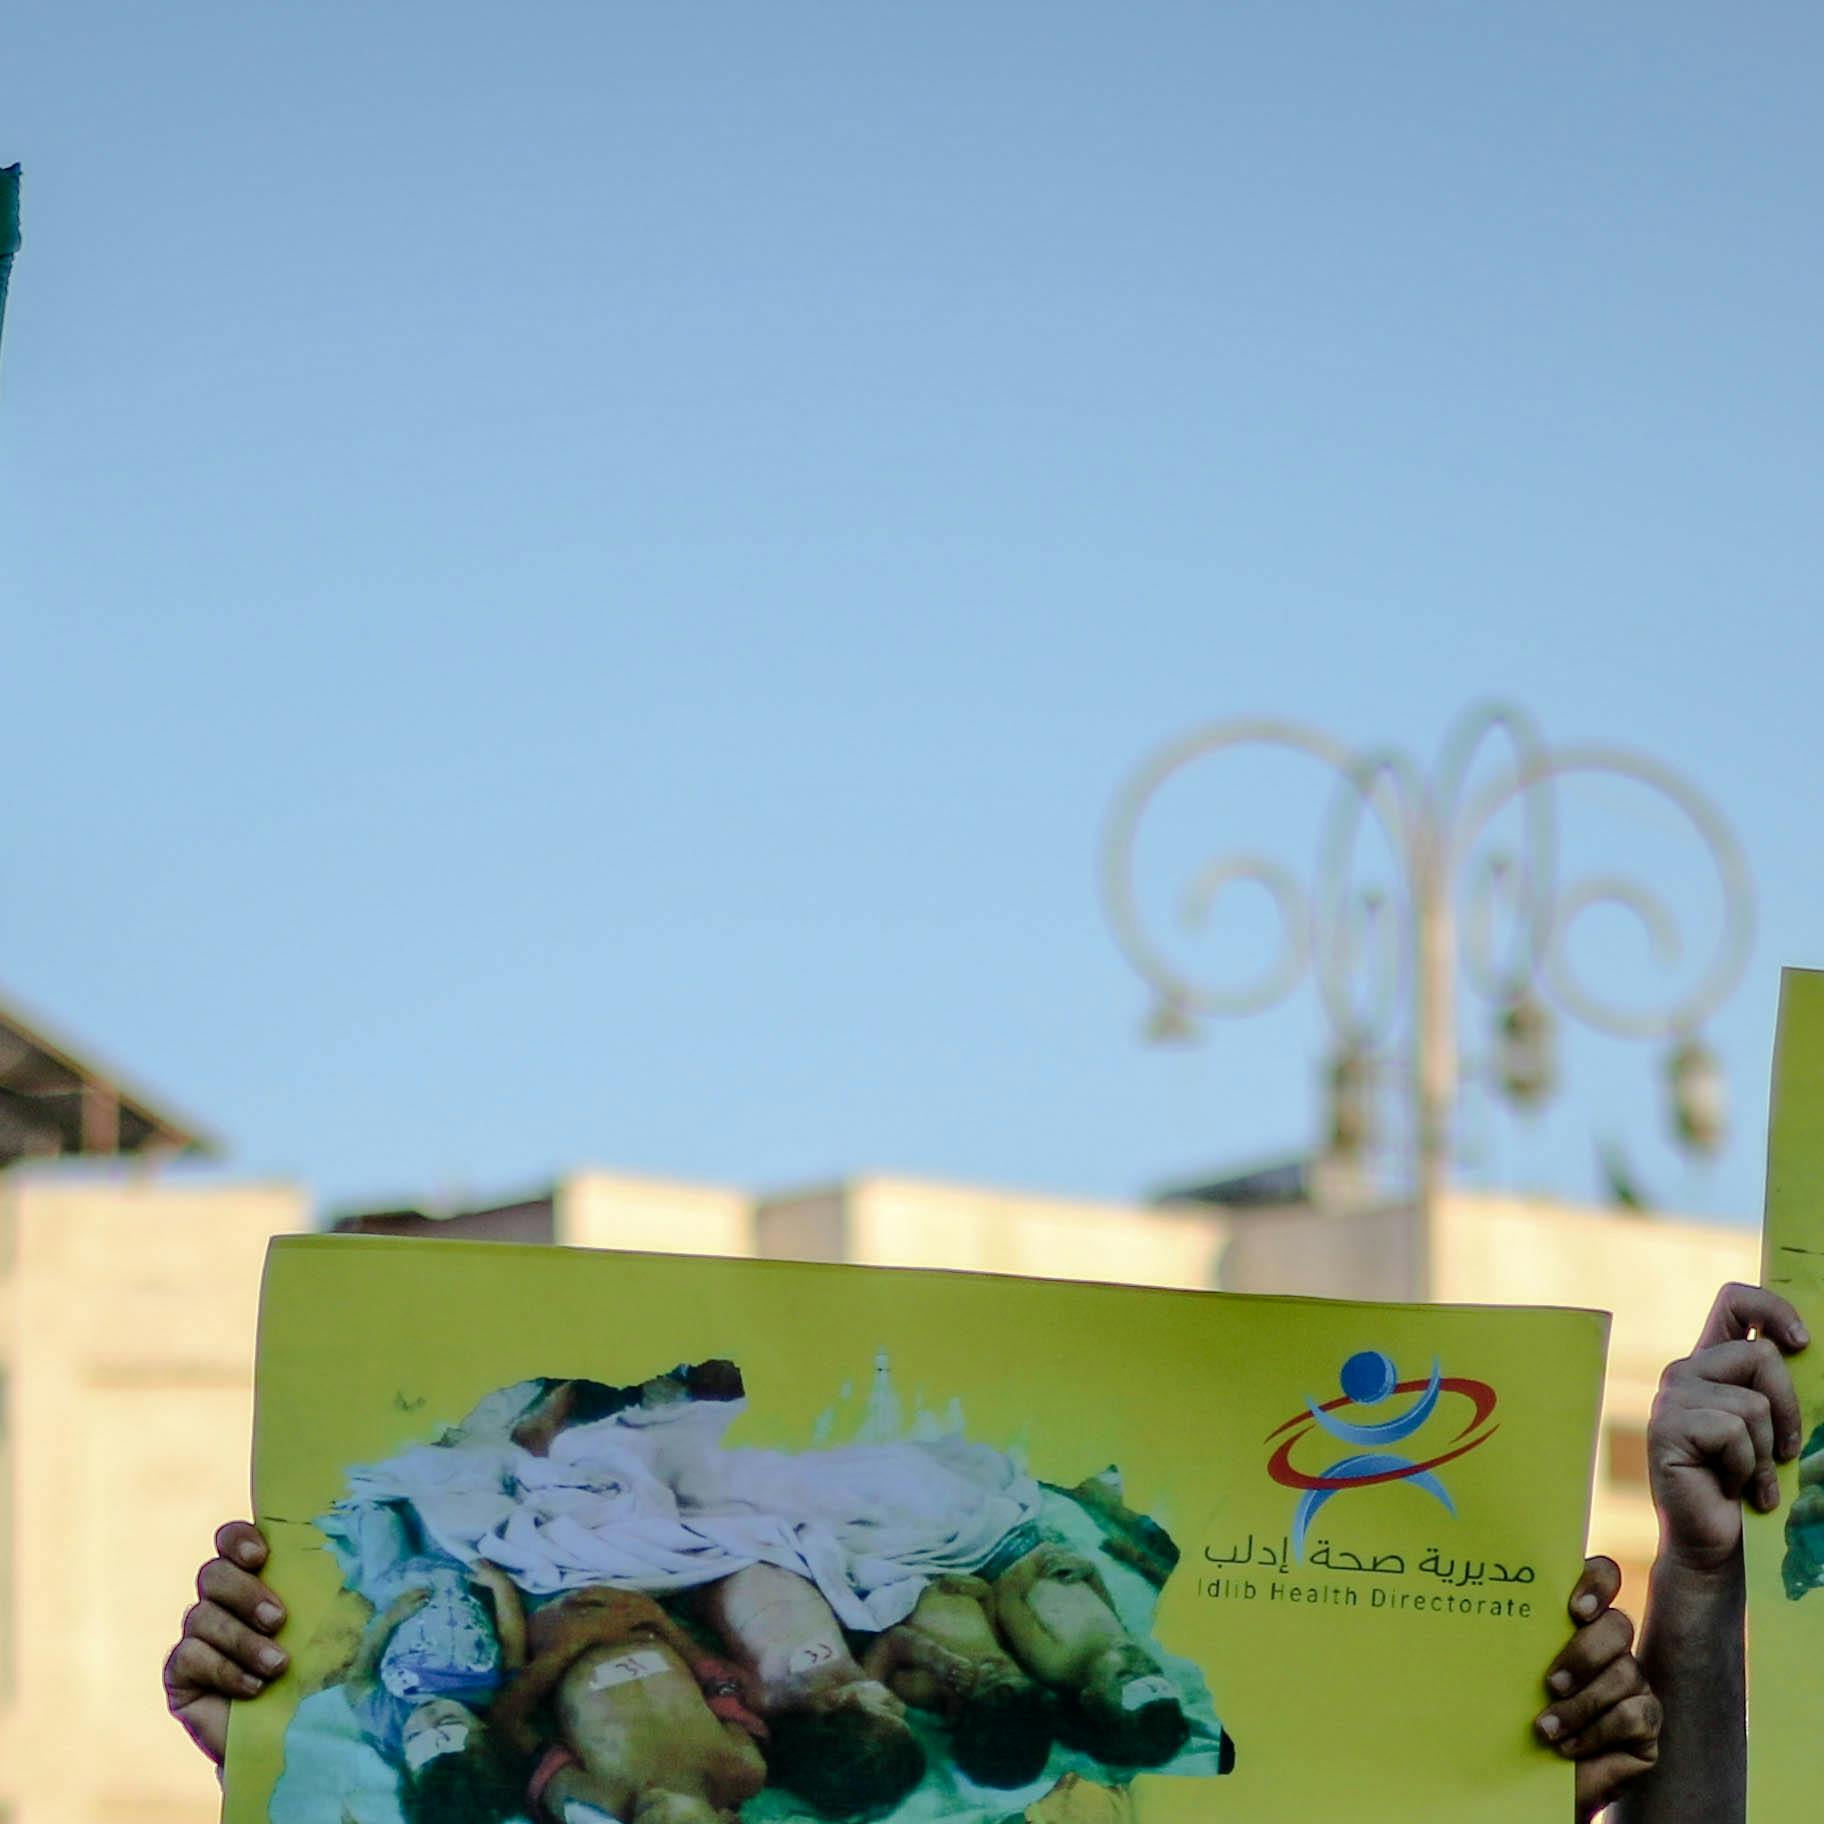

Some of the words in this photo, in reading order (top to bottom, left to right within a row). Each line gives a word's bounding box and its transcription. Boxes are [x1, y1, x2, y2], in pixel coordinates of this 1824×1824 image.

[1204, 1534, 1289, 1574] إدلب
[1309, 1539, 1405, 1574] صحة
[1418, 1547, 1536, 1586] مديرية
[1198, 1578, 1257, 1600] Idlib
[1270, 1582, 1357, 1606] Health
[1370, 1587, 1531, 1618] Directorate
